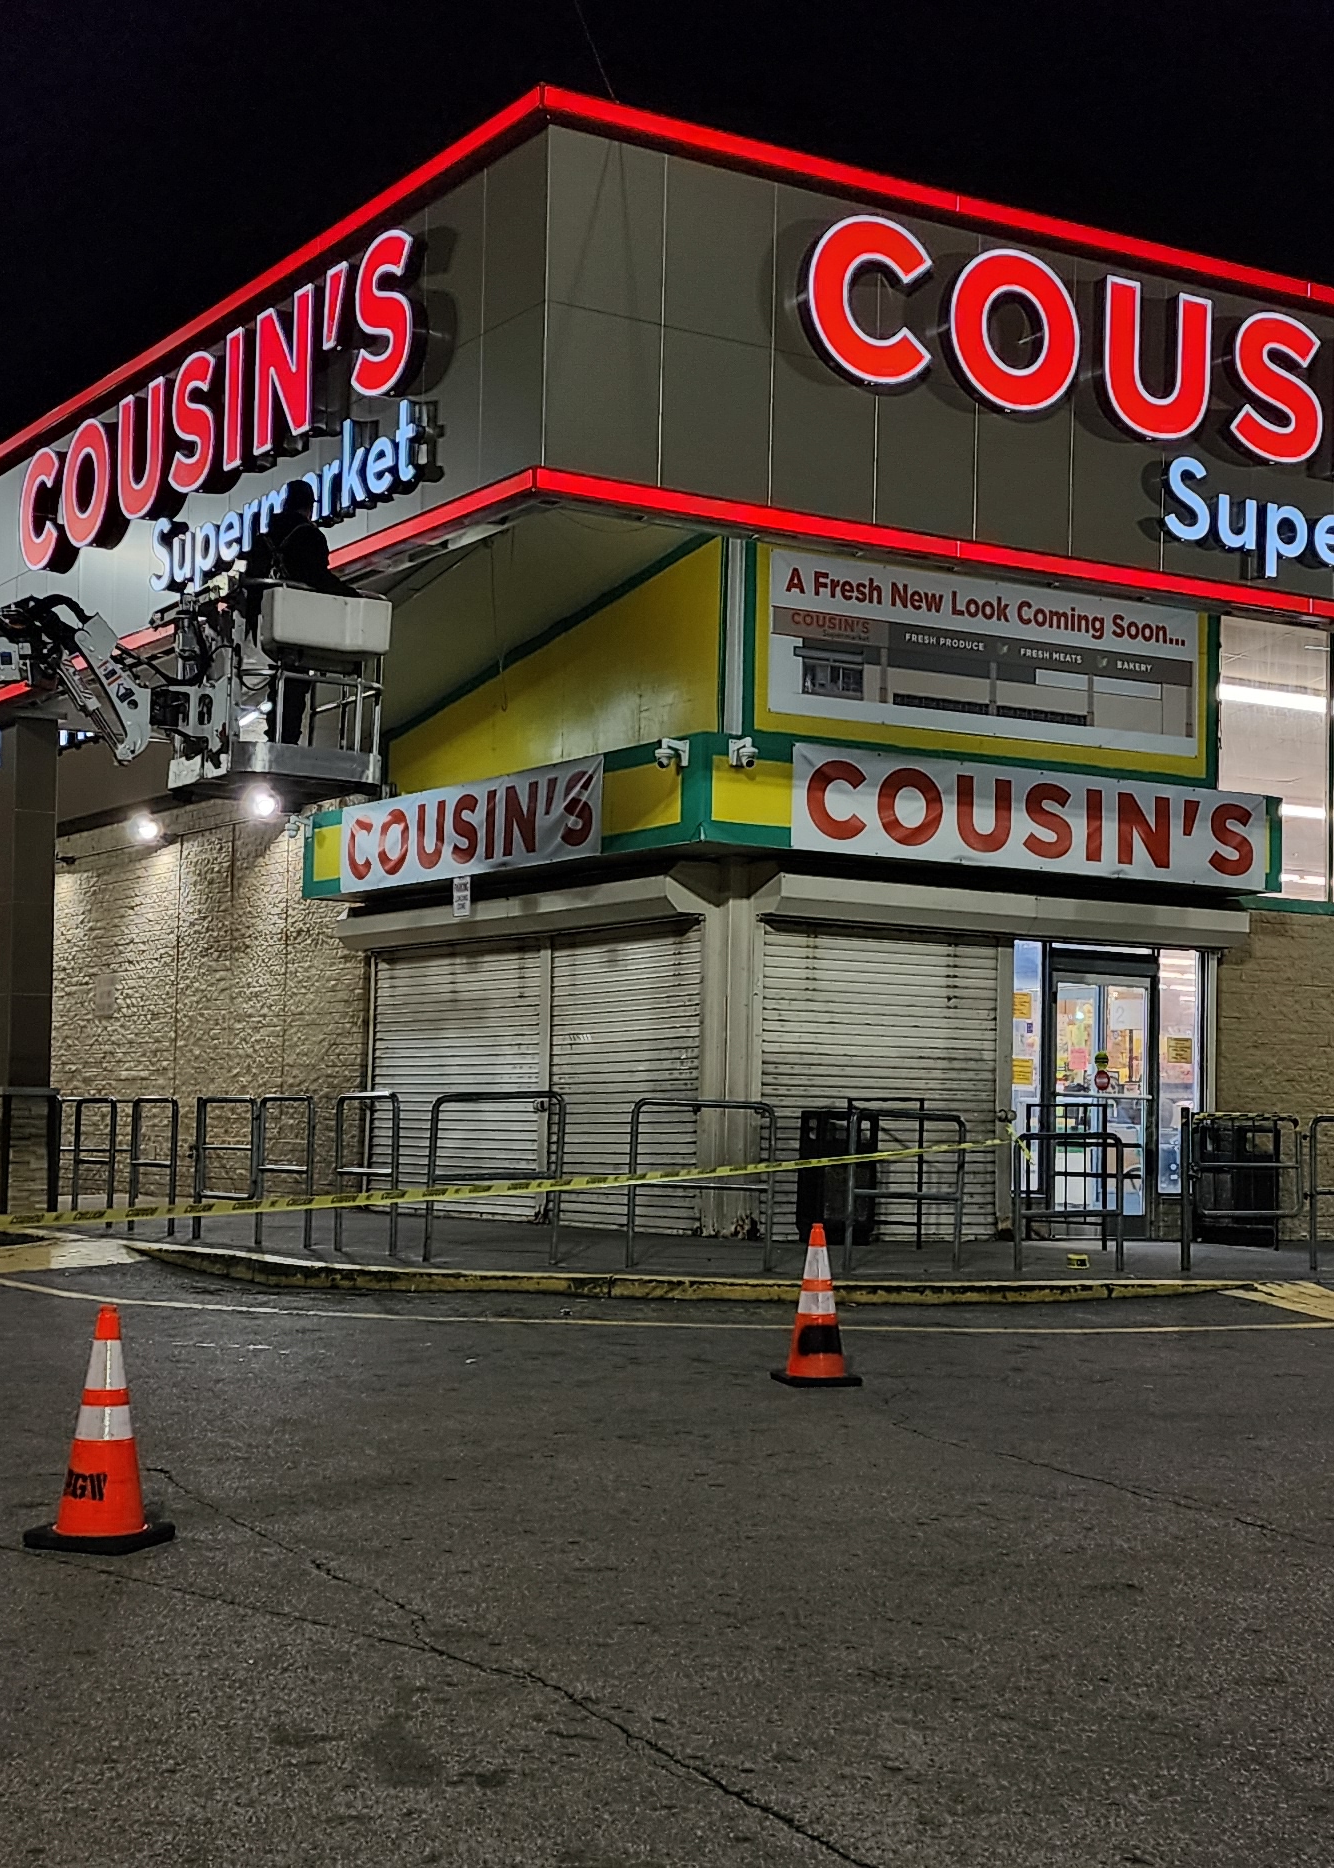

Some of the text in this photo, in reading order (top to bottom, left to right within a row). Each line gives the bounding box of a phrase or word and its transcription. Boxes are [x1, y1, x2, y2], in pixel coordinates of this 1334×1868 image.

[19, 229, 413, 572] COUSIN'S
[785, 567, 1186, 647] A Fresh New Look Coming Soon...
[791, 612, 870, 634] COUSIN'S
[905, 633, 985, 651] FRESH PRODUCE
[1020, 648, 1082, 664] FRESH MEATS
[1117, 660, 1152, 673] BAKERY
[346, 768, 597, 883] COUSIN'S
[805, 759, 1255, 878] COUSIN'S
